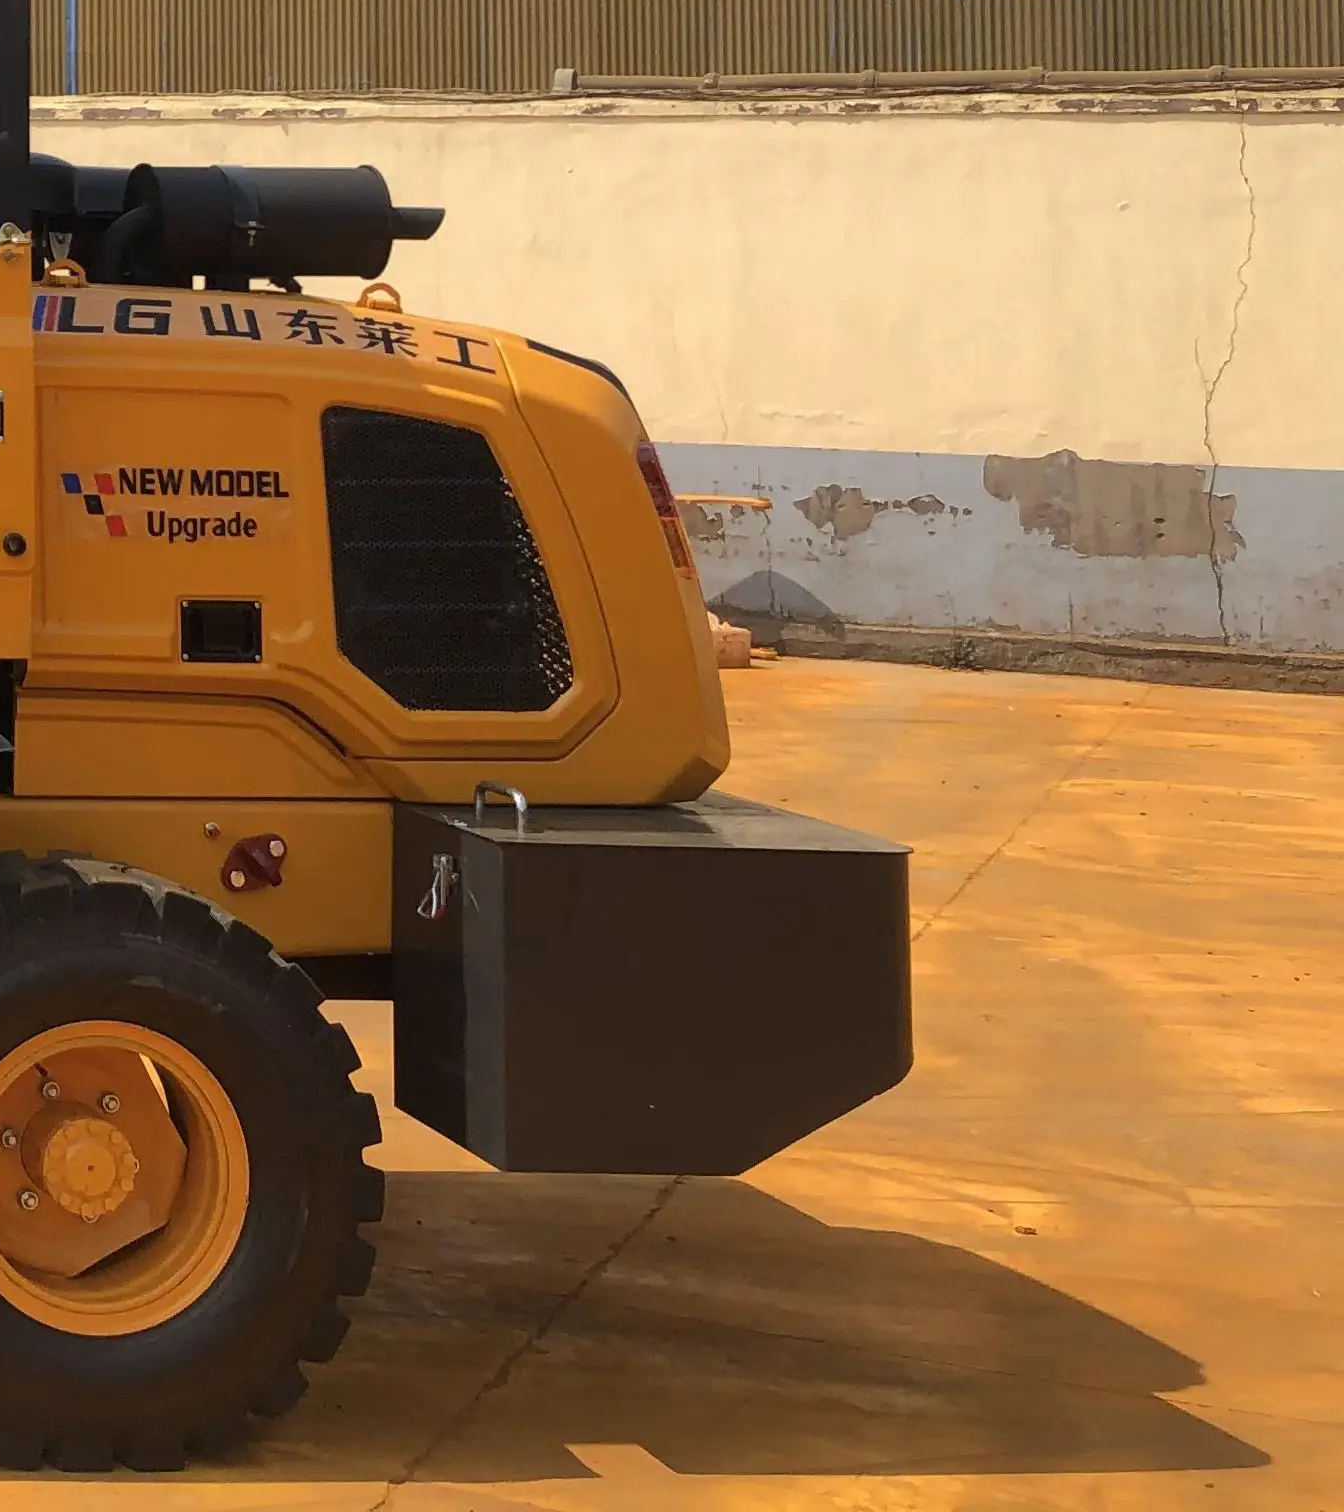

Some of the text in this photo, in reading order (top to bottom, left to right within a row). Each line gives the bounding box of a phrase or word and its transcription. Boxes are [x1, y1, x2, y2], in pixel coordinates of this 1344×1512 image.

[58, 295, 173, 336] LG
[199, 302, 497, 375] 山东莱工
[118, 467, 291, 498] NEW MODEL
[147, 510, 258, 544] Upgrade
